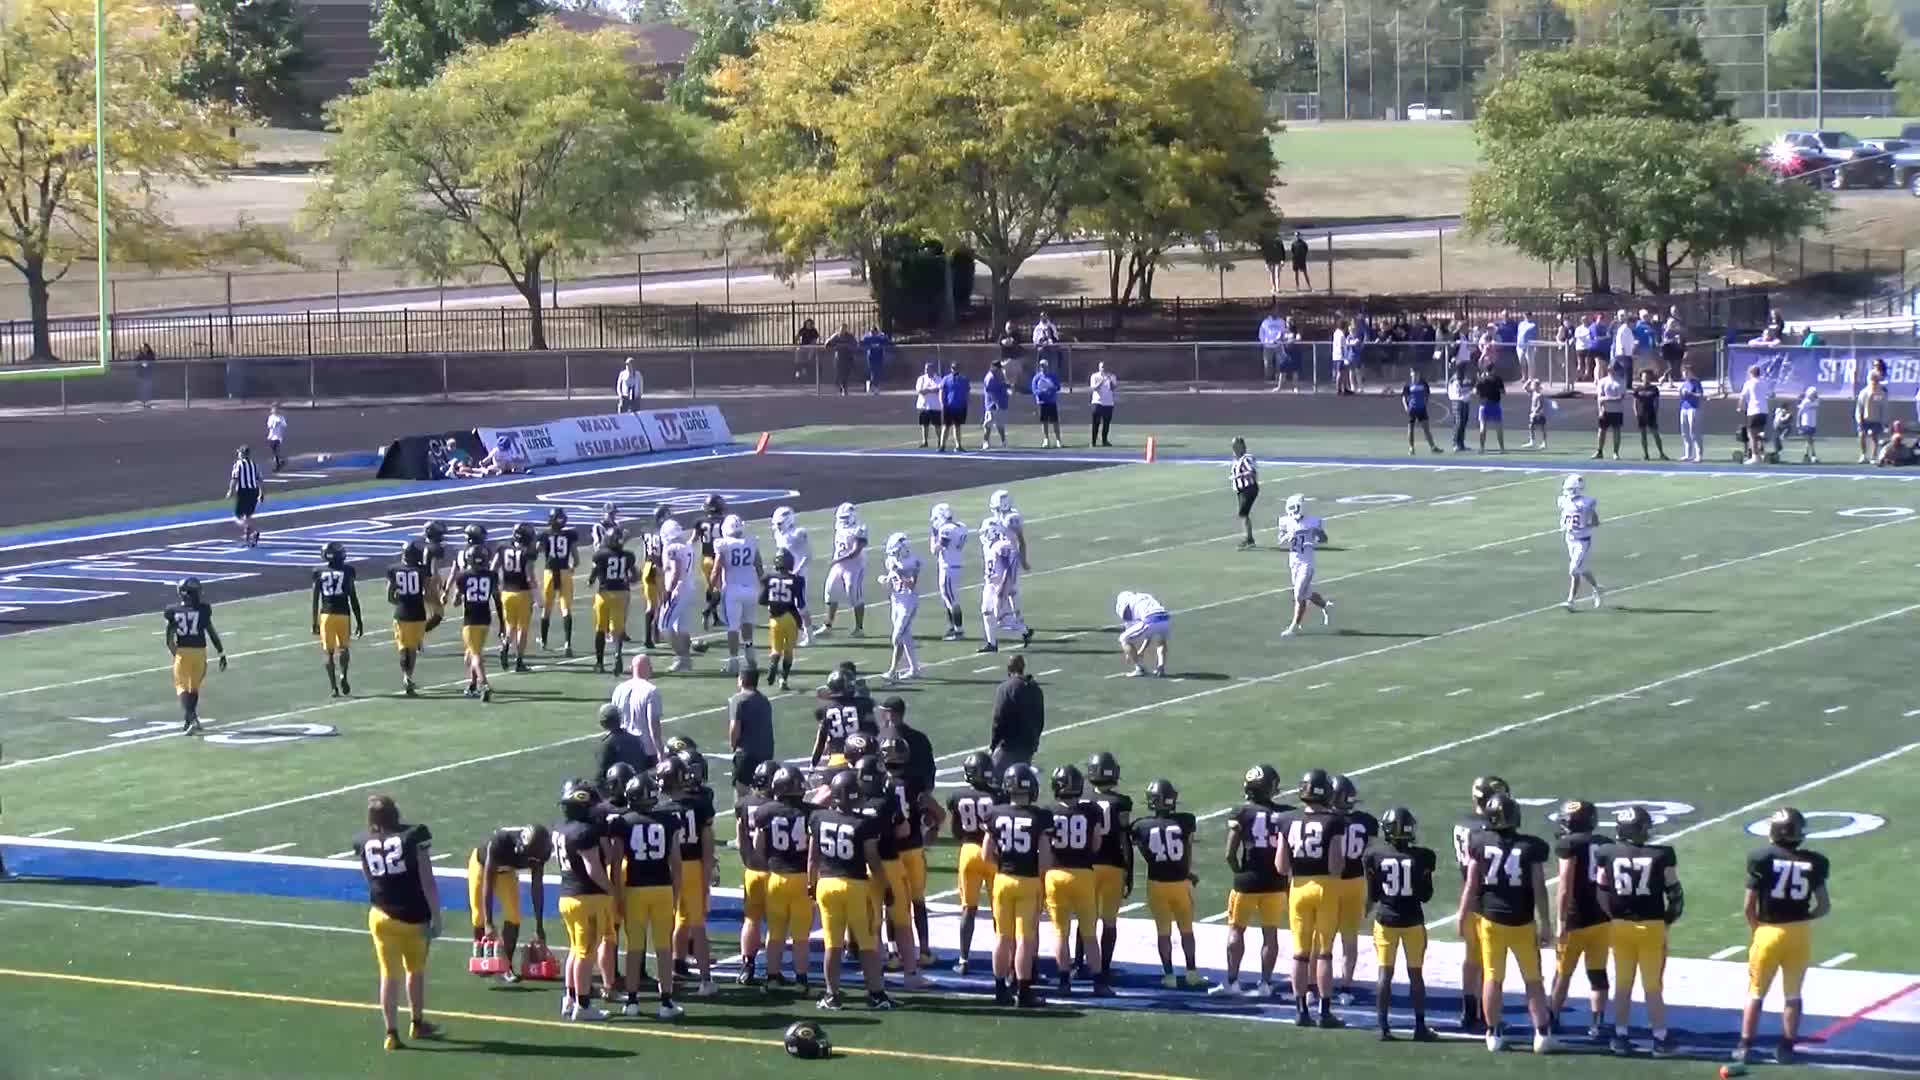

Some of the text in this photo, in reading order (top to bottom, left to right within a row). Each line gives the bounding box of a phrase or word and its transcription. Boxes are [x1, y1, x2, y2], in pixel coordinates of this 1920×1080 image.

[577, 417, 621, 433] WADE
[503, 548, 522, 573] 61
[549, 535, 568, 559] 19
[731, 548, 751, 567] 62
[320, 570, 345, 596] 27
[396, 571, 420, 595] 90
[606, 556, 627, 579] 21
[466, 576, 491, 602] 29
[768, 577, 794, 602] 25
[174, 611, 200, 636] 37
[825, 706, 860, 738] 33
[630, 823, 666, 861] 49
[771, 816, 808, 851] 64
[819, 821, 856, 861] 56
[995, 816, 1033, 854] 35
[1053, 814, 1088, 850] 38
[1150, 825, 1184, 862] 46
[1287, 820, 1324, 859] 42
[1342, 823, 1366, 859] 6
[364, 836, 407, 877] 62
[1484, 845, 1523, 887] 74
[1380, 857, 1413, 897] 31
[1612, 857, 1654, 896] 67
[1770, 858, 1813, 900] 75
